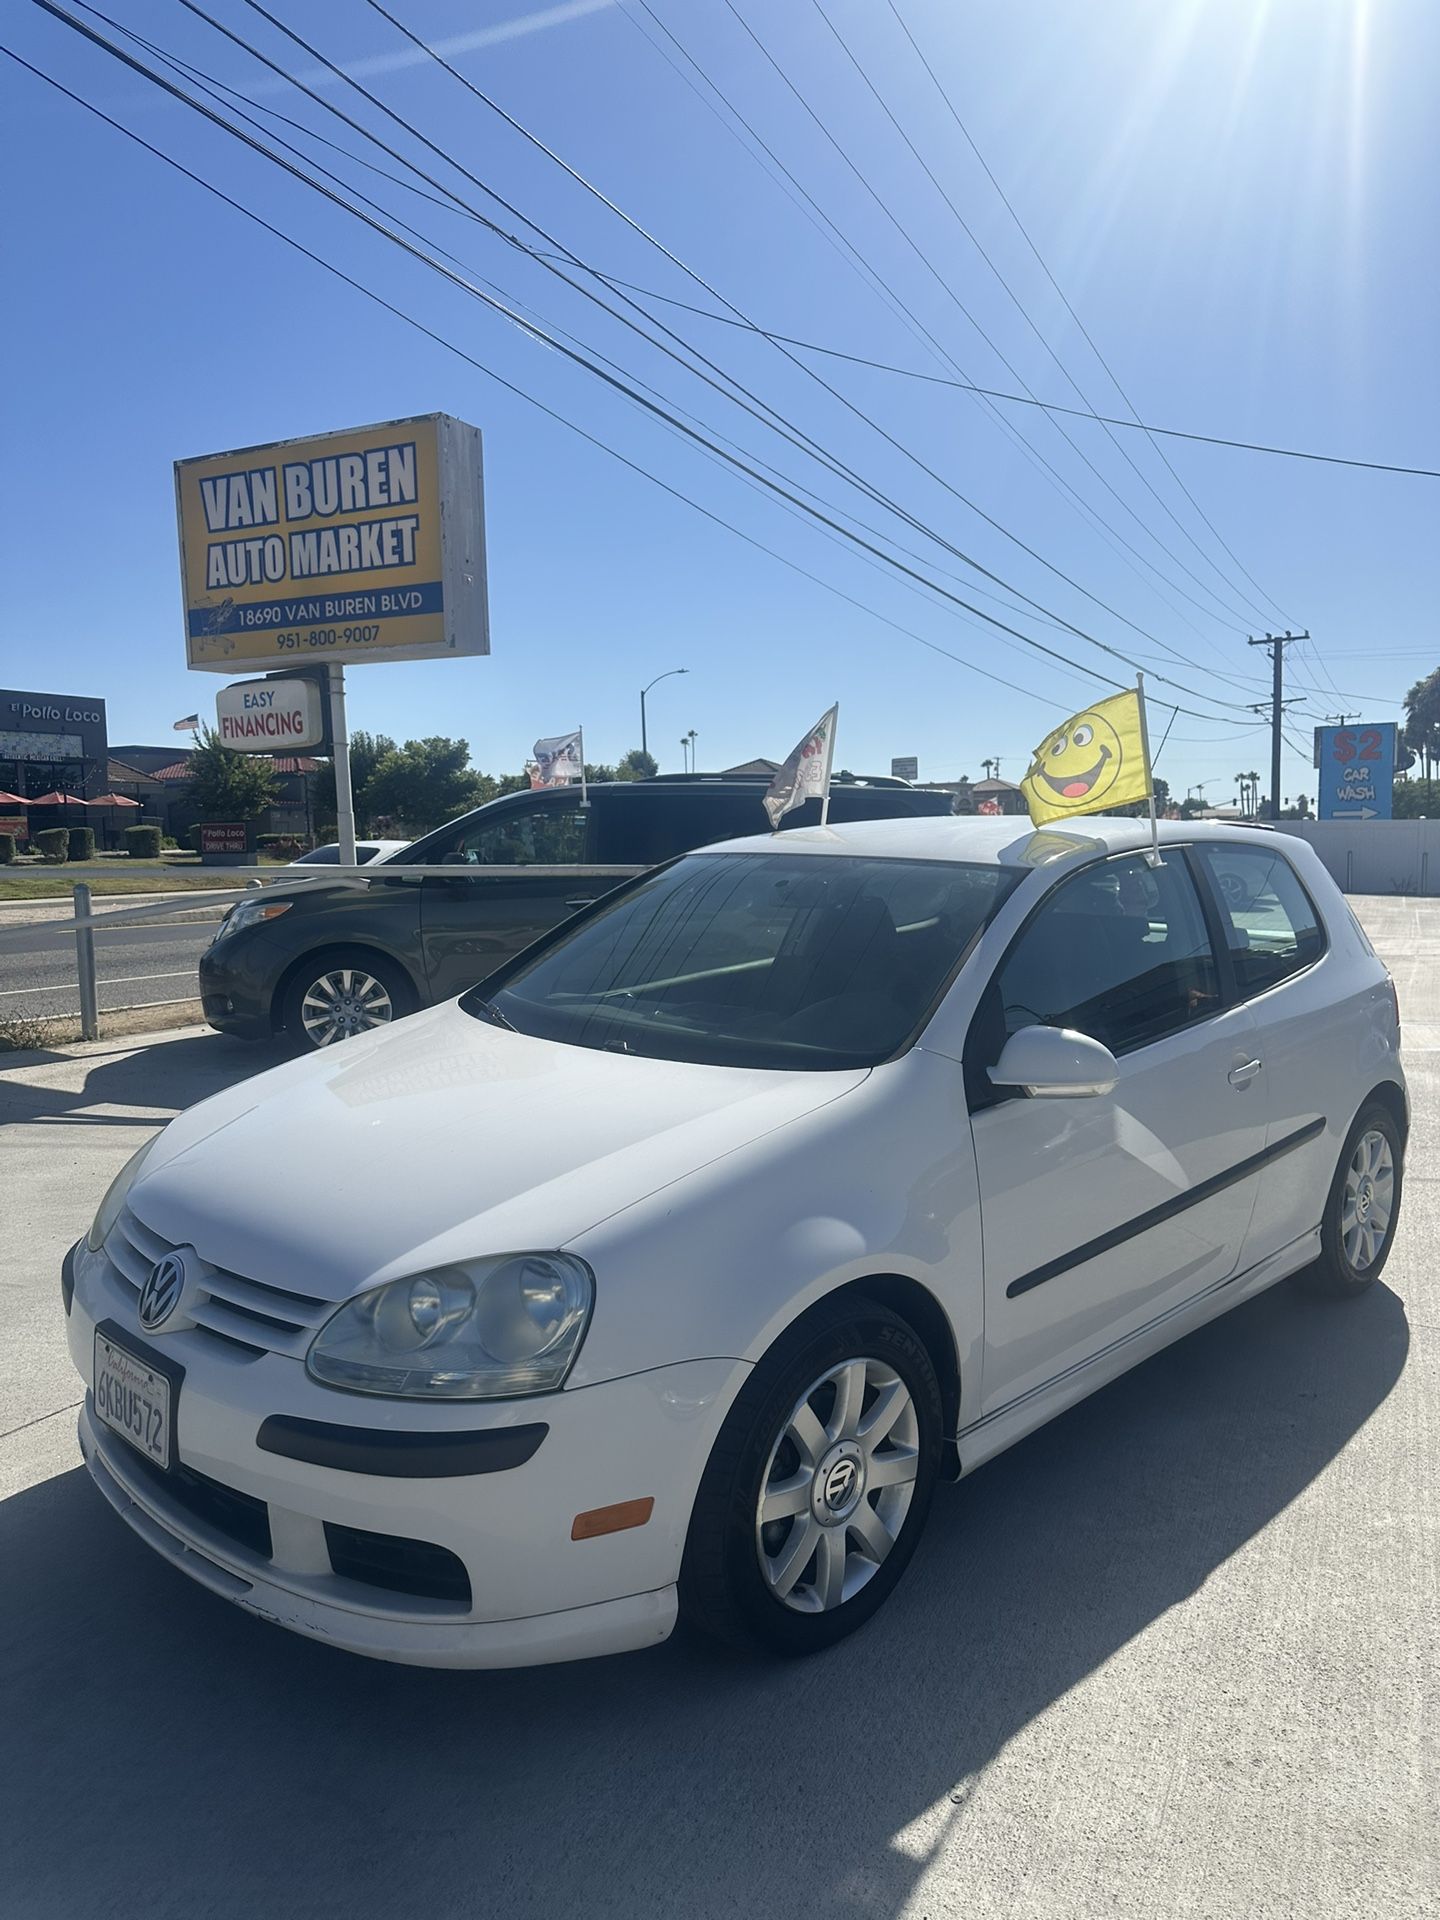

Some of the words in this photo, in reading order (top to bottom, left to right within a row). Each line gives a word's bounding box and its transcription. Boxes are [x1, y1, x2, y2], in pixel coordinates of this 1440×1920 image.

[200, 466, 279, 533] VAN
[283, 442, 418, 522] BUREN
[206, 534, 286, 590] AUTO
[290, 514, 419, 580] MARKET
[238, 606, 281, 626] 18690
[285, 603, 321, 621] VAN
[324, 596, 376, 618] BUREN
[381, 591, 423, 612] BLVD
[276, 625, 380, 650] 951-800-9007
[23, 703, 61, 720] Pollo
[65, 707, 101, 722] Loco
[243, 691, 275, 709] EASY
[222, 710, 303, 739] FINANCING
[1333, 730, 1383, 765] $2
[1342, 768, 1370, 782] CAR
[1337, 785, 1376, 800] WASH
[227, 829, 245, 838] Loco
[98, 1370, 163, 1454] 6KBU572
